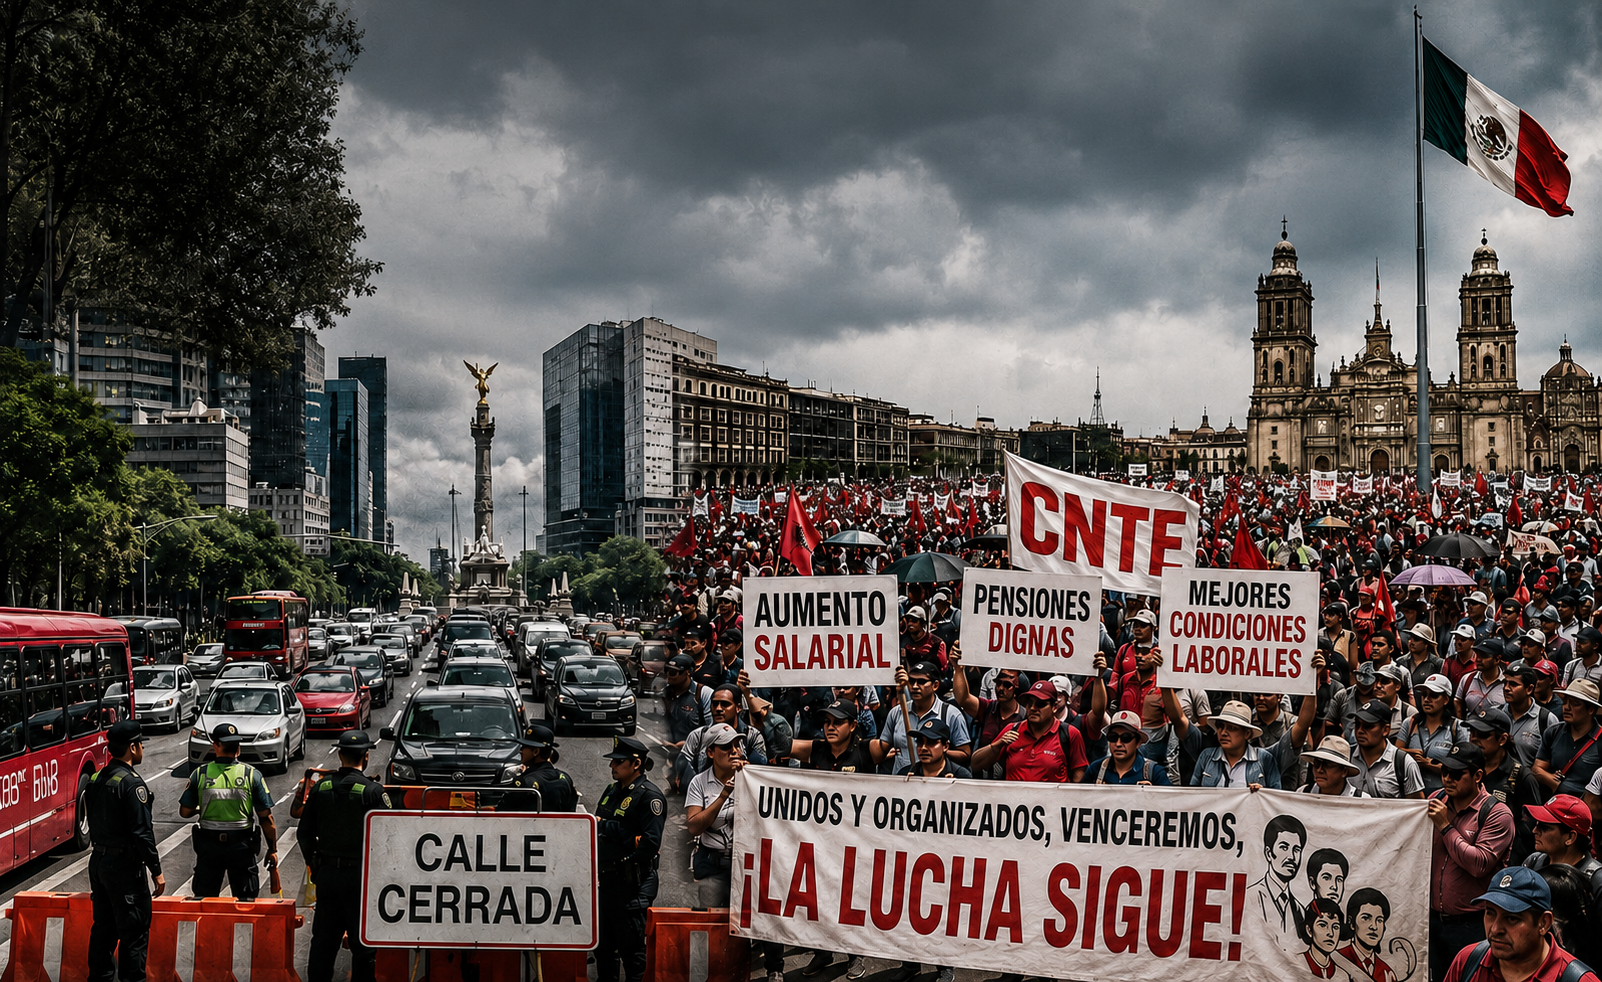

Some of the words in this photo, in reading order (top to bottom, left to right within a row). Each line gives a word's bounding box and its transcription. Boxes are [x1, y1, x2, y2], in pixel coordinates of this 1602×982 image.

[1020, 481, 1187, 577] CNTE
[753, 590, 887, 628] AUMENTO
[973, 583, 1091, 622] PENSIONES
[1188, 580, 1291, 610] MEJORES
[988, 621, 1074, 659] DIGNAS
[1170, 610, 1306, 644] CONDICIONES
[754, 632, 891, 671] SALARIAL
[1172, 643, 1302, 679] LABORALES
[758, 785, 844, 826] UNIDOS
[850, 793, 867, 828] Y
[873, 796, 1051, 848] ORGANIZADOS,
[1060, 806, 1244, 858] VENCEREMOS,
[414, 832, 547, 873] CALLE
[377, 883, 582, 926] CERRADA
[739, 837, 819, 929] ¡LA
[838, 845, 1023, 944] LUCHA
[1043, 862, 1247, 962] SIGUE!
